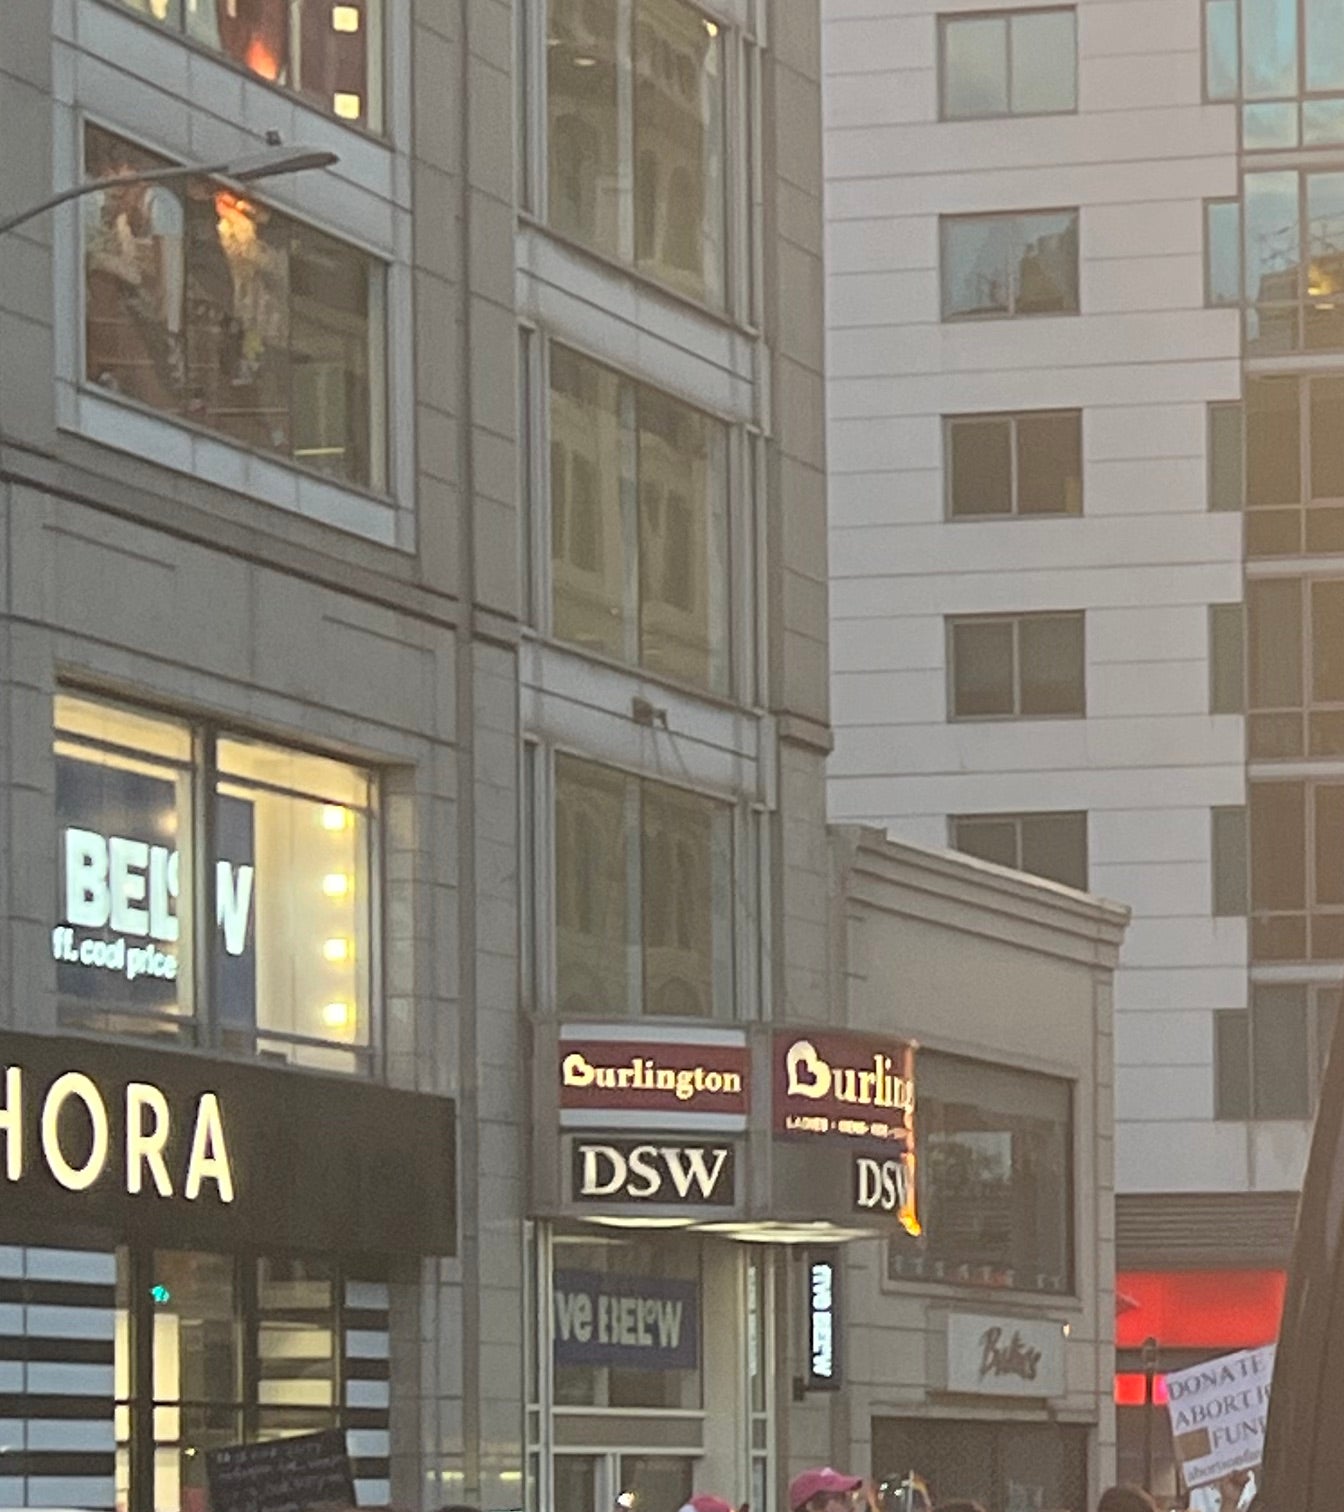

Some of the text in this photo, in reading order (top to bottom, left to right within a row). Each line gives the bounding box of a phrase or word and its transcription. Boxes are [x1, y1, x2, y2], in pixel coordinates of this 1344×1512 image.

[66, 827, 253, 955] BELW
[126, 944, 178, 980] price
[562, 1054, 741, 1100] Burlington
[577, 1145, 729, 1200] DSW
[1167, 1354, 1267, 1401] DONATE
